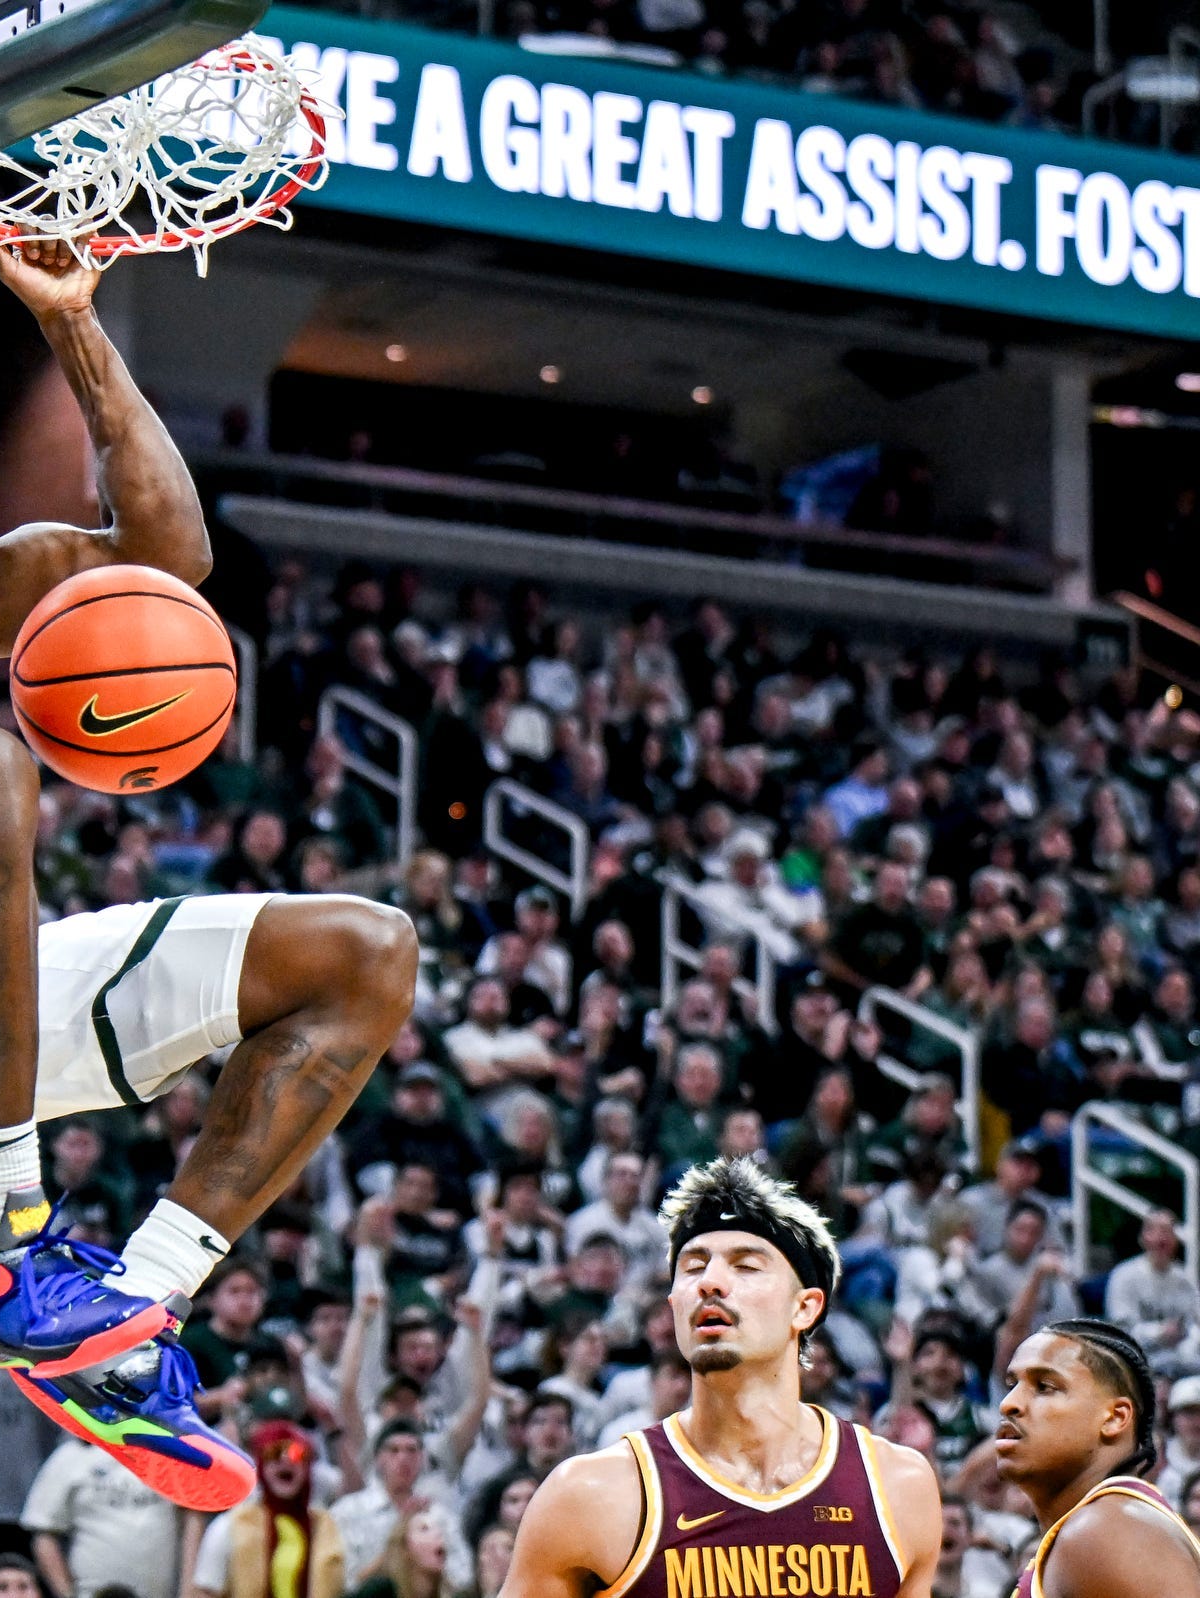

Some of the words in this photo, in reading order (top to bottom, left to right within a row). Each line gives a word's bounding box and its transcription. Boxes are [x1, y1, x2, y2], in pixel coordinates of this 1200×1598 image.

[406, 62, 473, 183] A
[479, 74, 736, 222] GREAT
[741, 117, 1027, 272] ASSIST.
[664, 1543, 873, 1598] MINNESOTA
